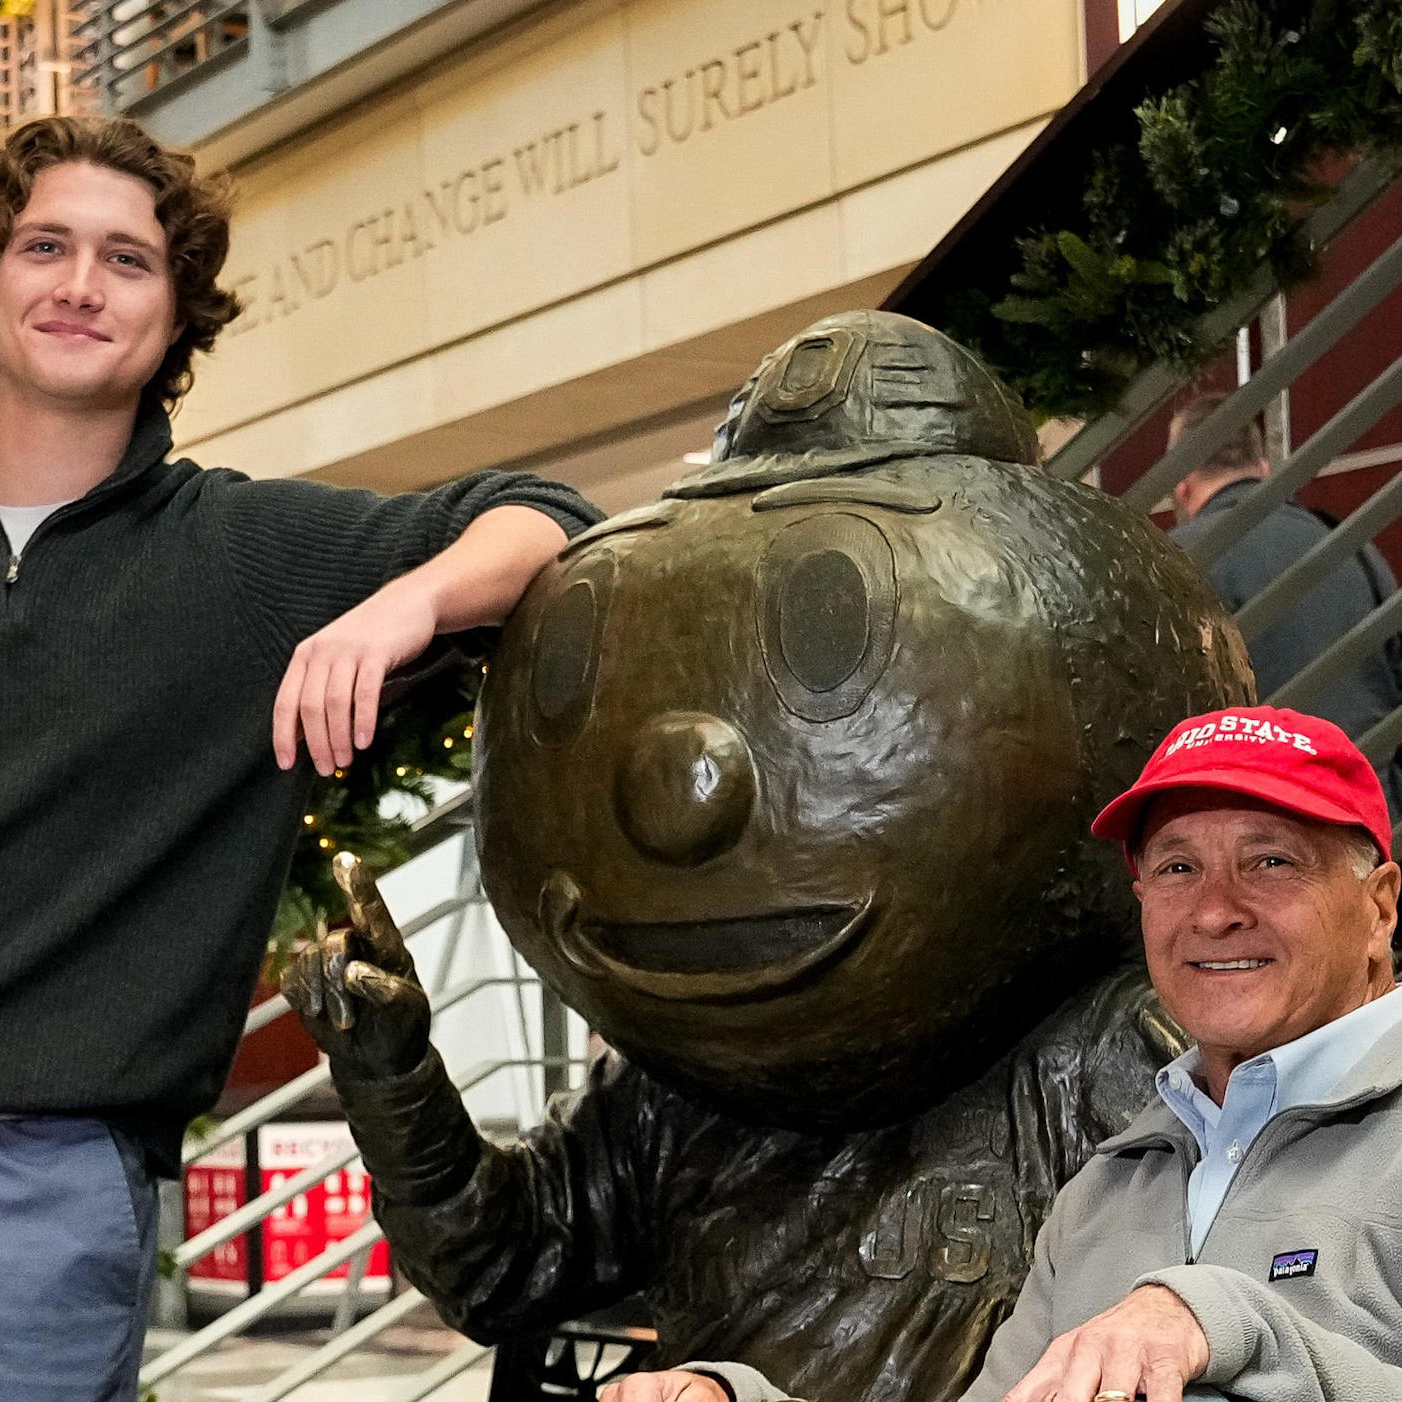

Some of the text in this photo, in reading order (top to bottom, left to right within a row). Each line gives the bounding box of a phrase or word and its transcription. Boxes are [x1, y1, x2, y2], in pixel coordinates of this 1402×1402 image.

[263, 238, 338, 323] AND
[344, 157, 509, 282] CHANGE
[513, 110, 620, 195] WILL
[636, 12, 826, 157] SURELY
[844, 0, 984, 66] SHO
[1165, 716, 1313, 756] OHIO STATE
[1274, 1263, 1308, 1277] patagonia
